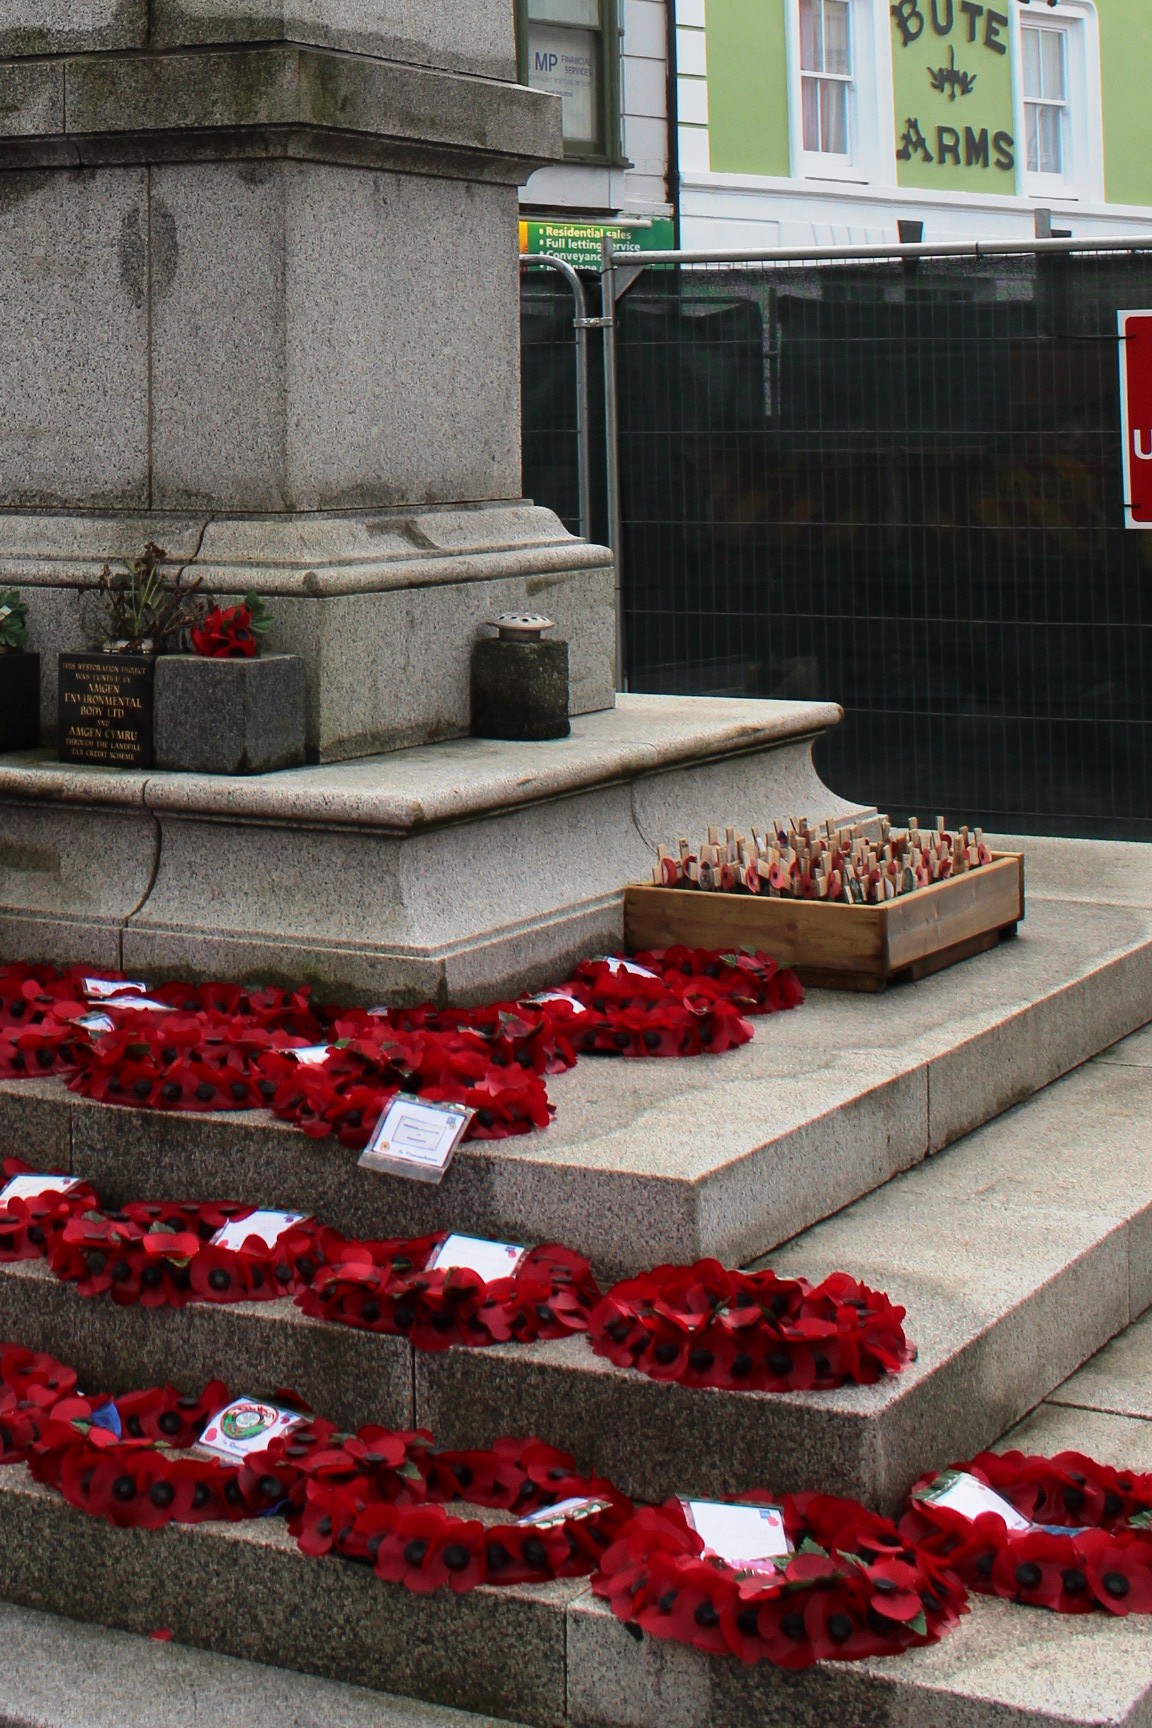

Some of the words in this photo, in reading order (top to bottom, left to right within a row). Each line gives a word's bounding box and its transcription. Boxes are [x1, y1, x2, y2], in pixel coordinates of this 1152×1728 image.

[535, 52, 558, 72] MP
[896, 117, 1015, 171] ARMS
[545, 227, 604, 238] Residential
[606, 229, 632, 240] sales
[546, 238, 565, 248] Full
[611, 243, 641, 252] ervice
[88, 683, 120, 693] AMGEN
[64, 693, 142, 708] ENVIRONMENTAL
[80, 706, 102, 716] BODY
[108, 708, 124, 718] LTD
[97, 719, 110, 727] AND
[69, 726, 101, 738] AMGEN
[105, 729, 138, 741] CYMRU
[96, 740, 108, 748] THE
[111, 742, 141, 751] LANDFILL
[109, 752, 135, 761] SCHEME
